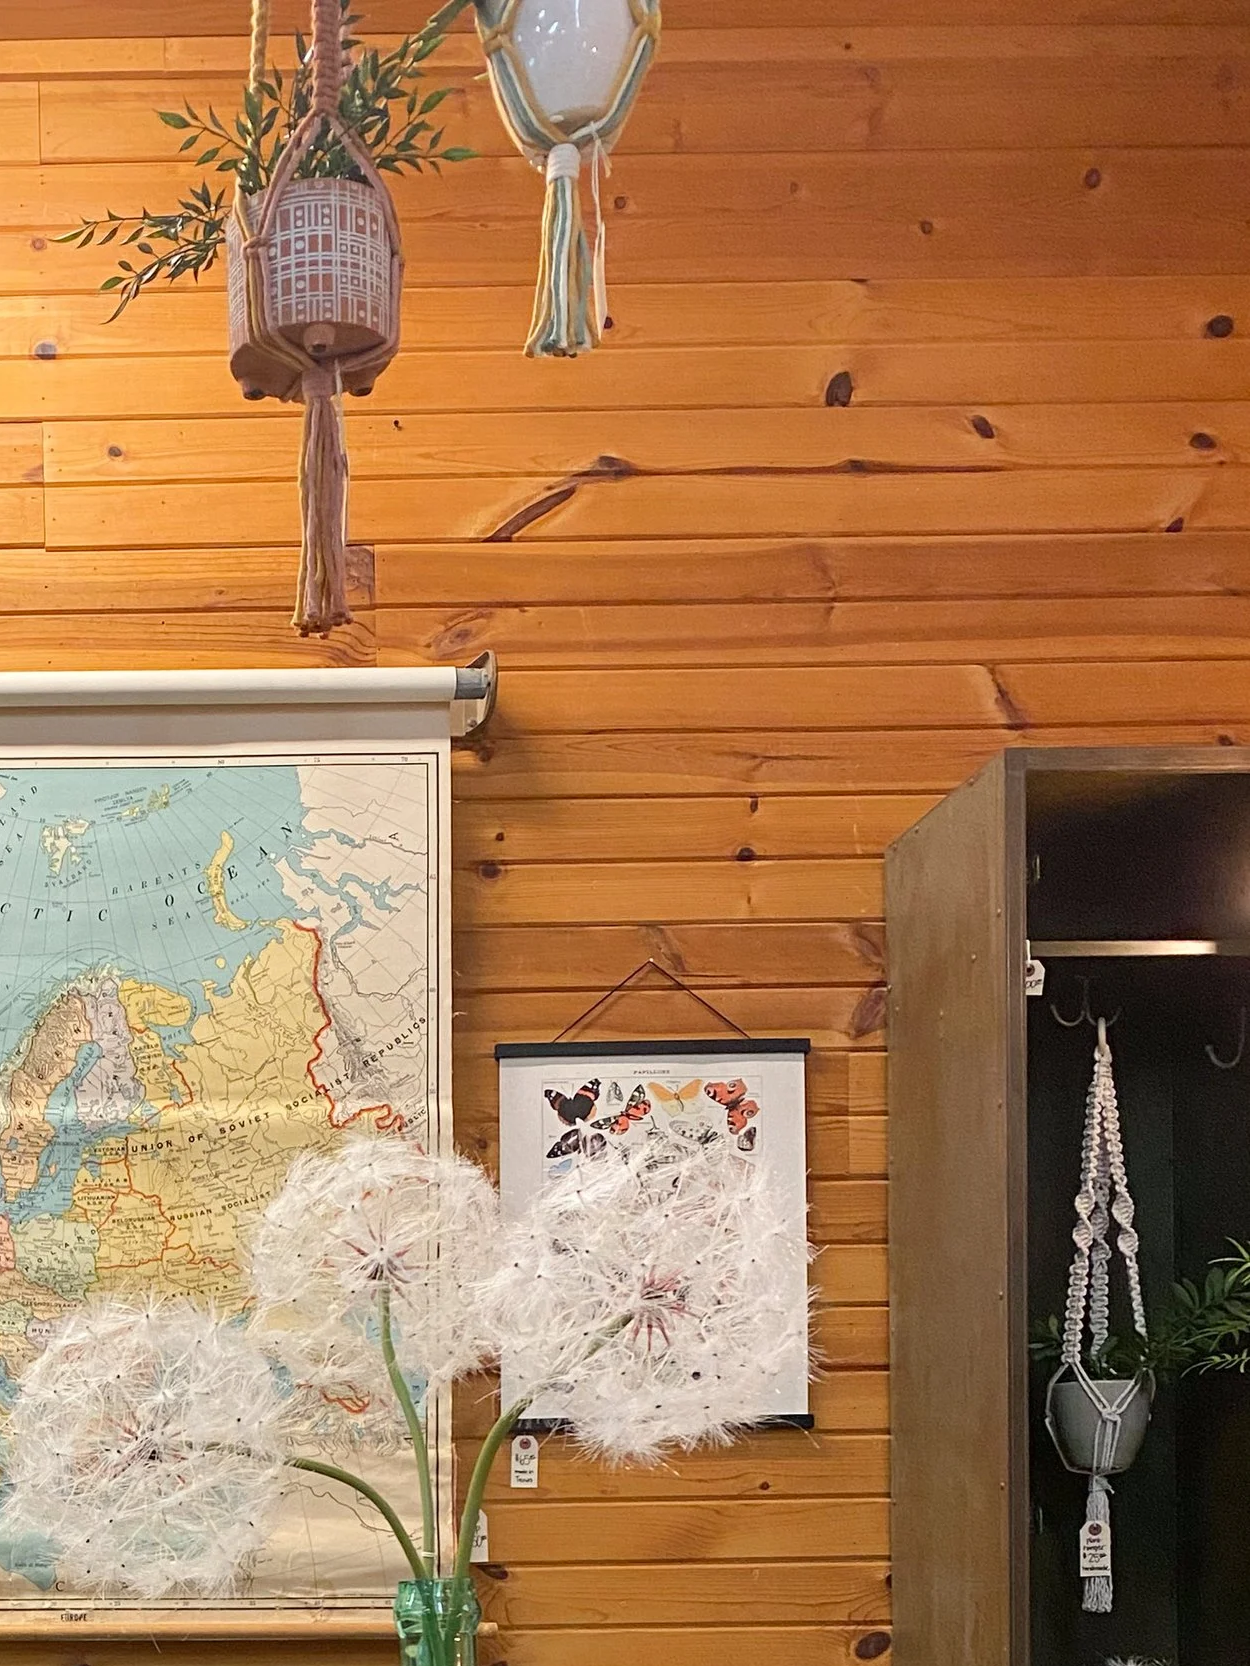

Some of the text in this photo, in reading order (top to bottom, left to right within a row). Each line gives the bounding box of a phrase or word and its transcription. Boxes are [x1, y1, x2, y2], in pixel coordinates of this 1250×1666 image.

[112, 861, 201, 895] BARENTS
[164, 822, 293, 907] OCEAN
[151, 912, 191, 931] SEA
[362, 1017, 426, 1067] REPUBLICS
[131, 1073, 350, 1153] UNION OF SOVIET SOCIALIST
[169, 1190, 272, 1221] RUSSIAN SOCIALIST
[61, 1613, 87, 1622] EUROPE
